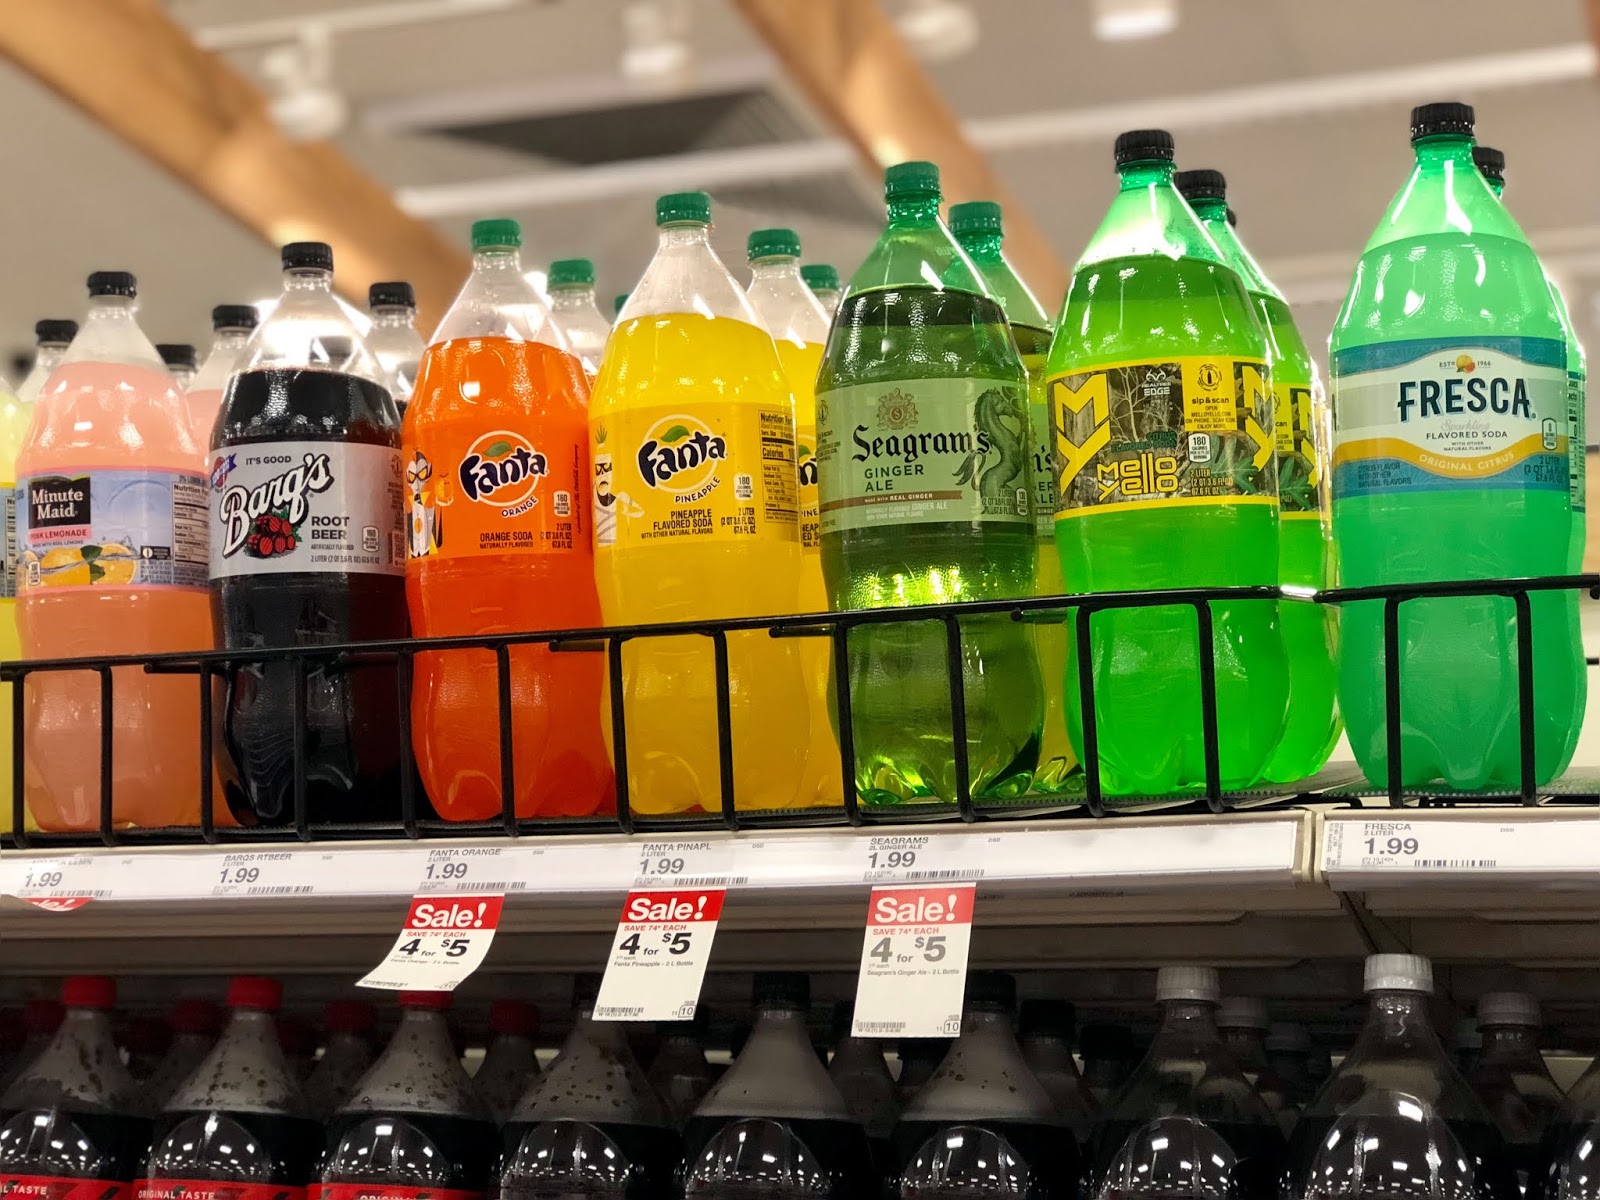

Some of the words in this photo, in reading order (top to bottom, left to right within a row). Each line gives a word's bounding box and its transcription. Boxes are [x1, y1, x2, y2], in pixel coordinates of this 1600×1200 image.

[1144, 387, 1171, 396] EDGE
[1191, 397, 1205, 405] sip
[1397, 377, 1531, 422] FRESCA
[760, 413, 784, 424] Nutrition
[1192, 436, 1206, 446] 180
[1426, 431, 1478, 440] FLAVORED
[852, 422, 991, 463] Seagram's
[762, 447, 784, 458] Calories
[246, 457, 261, 465] IT'S
[263, 455, 292, 464] GOOD
[638, 431, 726, 487] Fanta
[1419, 454, 1473, 471] ORIGINAL
[1478, 451, 1515, 470] CITRUS
[864, 464, 925, 480] GINGER
[1377, 463, 1401, 471] FLAVOR
[459, 447, 547, 501] Fanta
[1190, 470, 1194, 478] 2
[1196, 469, 1211, 477] LITER
[738, 476, 751, 485] 180
[865, 479, 894, 493] ALE
[1383, 477, 1412, 486] FLAVORS
[174, 484, 200, 494] Nutrition
[675, 476, 721, 503] PINEAPPLE
[1204, 487, 1211, 495] FL
[1212, 487, 1219, 495] OZ
[32, 488, 84, 505] Minute
[557, 494, 567, 502] 160
[37, 502, 76, 520] Maid
[220, 453, 335, 559] Barq's
[501, 496, 538, 517] ORANGE
[742, 507, 755, 515] LITER
[911, 502, 935, 511] GINGER
[936, 501, 948, 510] ALE
[670, 508, 712, 520] PINEAPPLE
[311, 516, 350, 527] ROOT
[653, 519, 691, 531] FLAVORED
[692, 518, 713, 528] SODA
[45, 529, 87, 539] LEMONADE
[311, 529, 347, 539] BEER
[480, 532, 511, 542] ORANGE
[512, 531, 533, 541] SODA
[669, 529, 691, 537] NATURAL
[692, 527, 713, 535] FLAVORS
[480, 541, 507, 549] NATURALLY
[315, 555, 327, 563] LITER
[1364, 823, 1412, 831] FRESCA
[870, 836, 929, 845] SEAGRAMS
[642, 843, 675, 851] FANTA
[676, 842, 712, 851] PINAPL
[1364, 838, 1419, 855] 1.99
[224, 854, 256, 862] BARQS
[256, 853, 292, 861] RTBEER
[429, 849, 459, 857] FANTA
[461, 848, 502, 856] ORANGE
[868, 851, 916, 869] 1.99
[425, 862, 468, 880] 1.99
[640, 858, 685, 875] 1.99
[25, 872, 63, 888] 1.99
[220, 867, 260, 884] 1.99
[627, 895, 708, 921] Sale!
[874, 894, 958, 923] Sale!
[411, 902, 487, 928] Sale!
[914, 927, 940, 935] EACH
[398, 938, 422, 955] 4
[440, 938, 471, 957] $5
[618, 933, 641, 955] 4
[643, 947, 660, 955] for
[662, 932, 692, 955] $5
[870, 937, 893, 963] 4
[896, 953, 914, 963] for
[914, 936, 946, 963] $5
[681, 1007, 694, 1016] 10
[946, 1022, 959, 1031] 10
[13, 1185, 47, 1195] TASTE
[138, 1190, 176, 1200] ORIGINAL
[179, 1190, 215, 1200] TASTE
